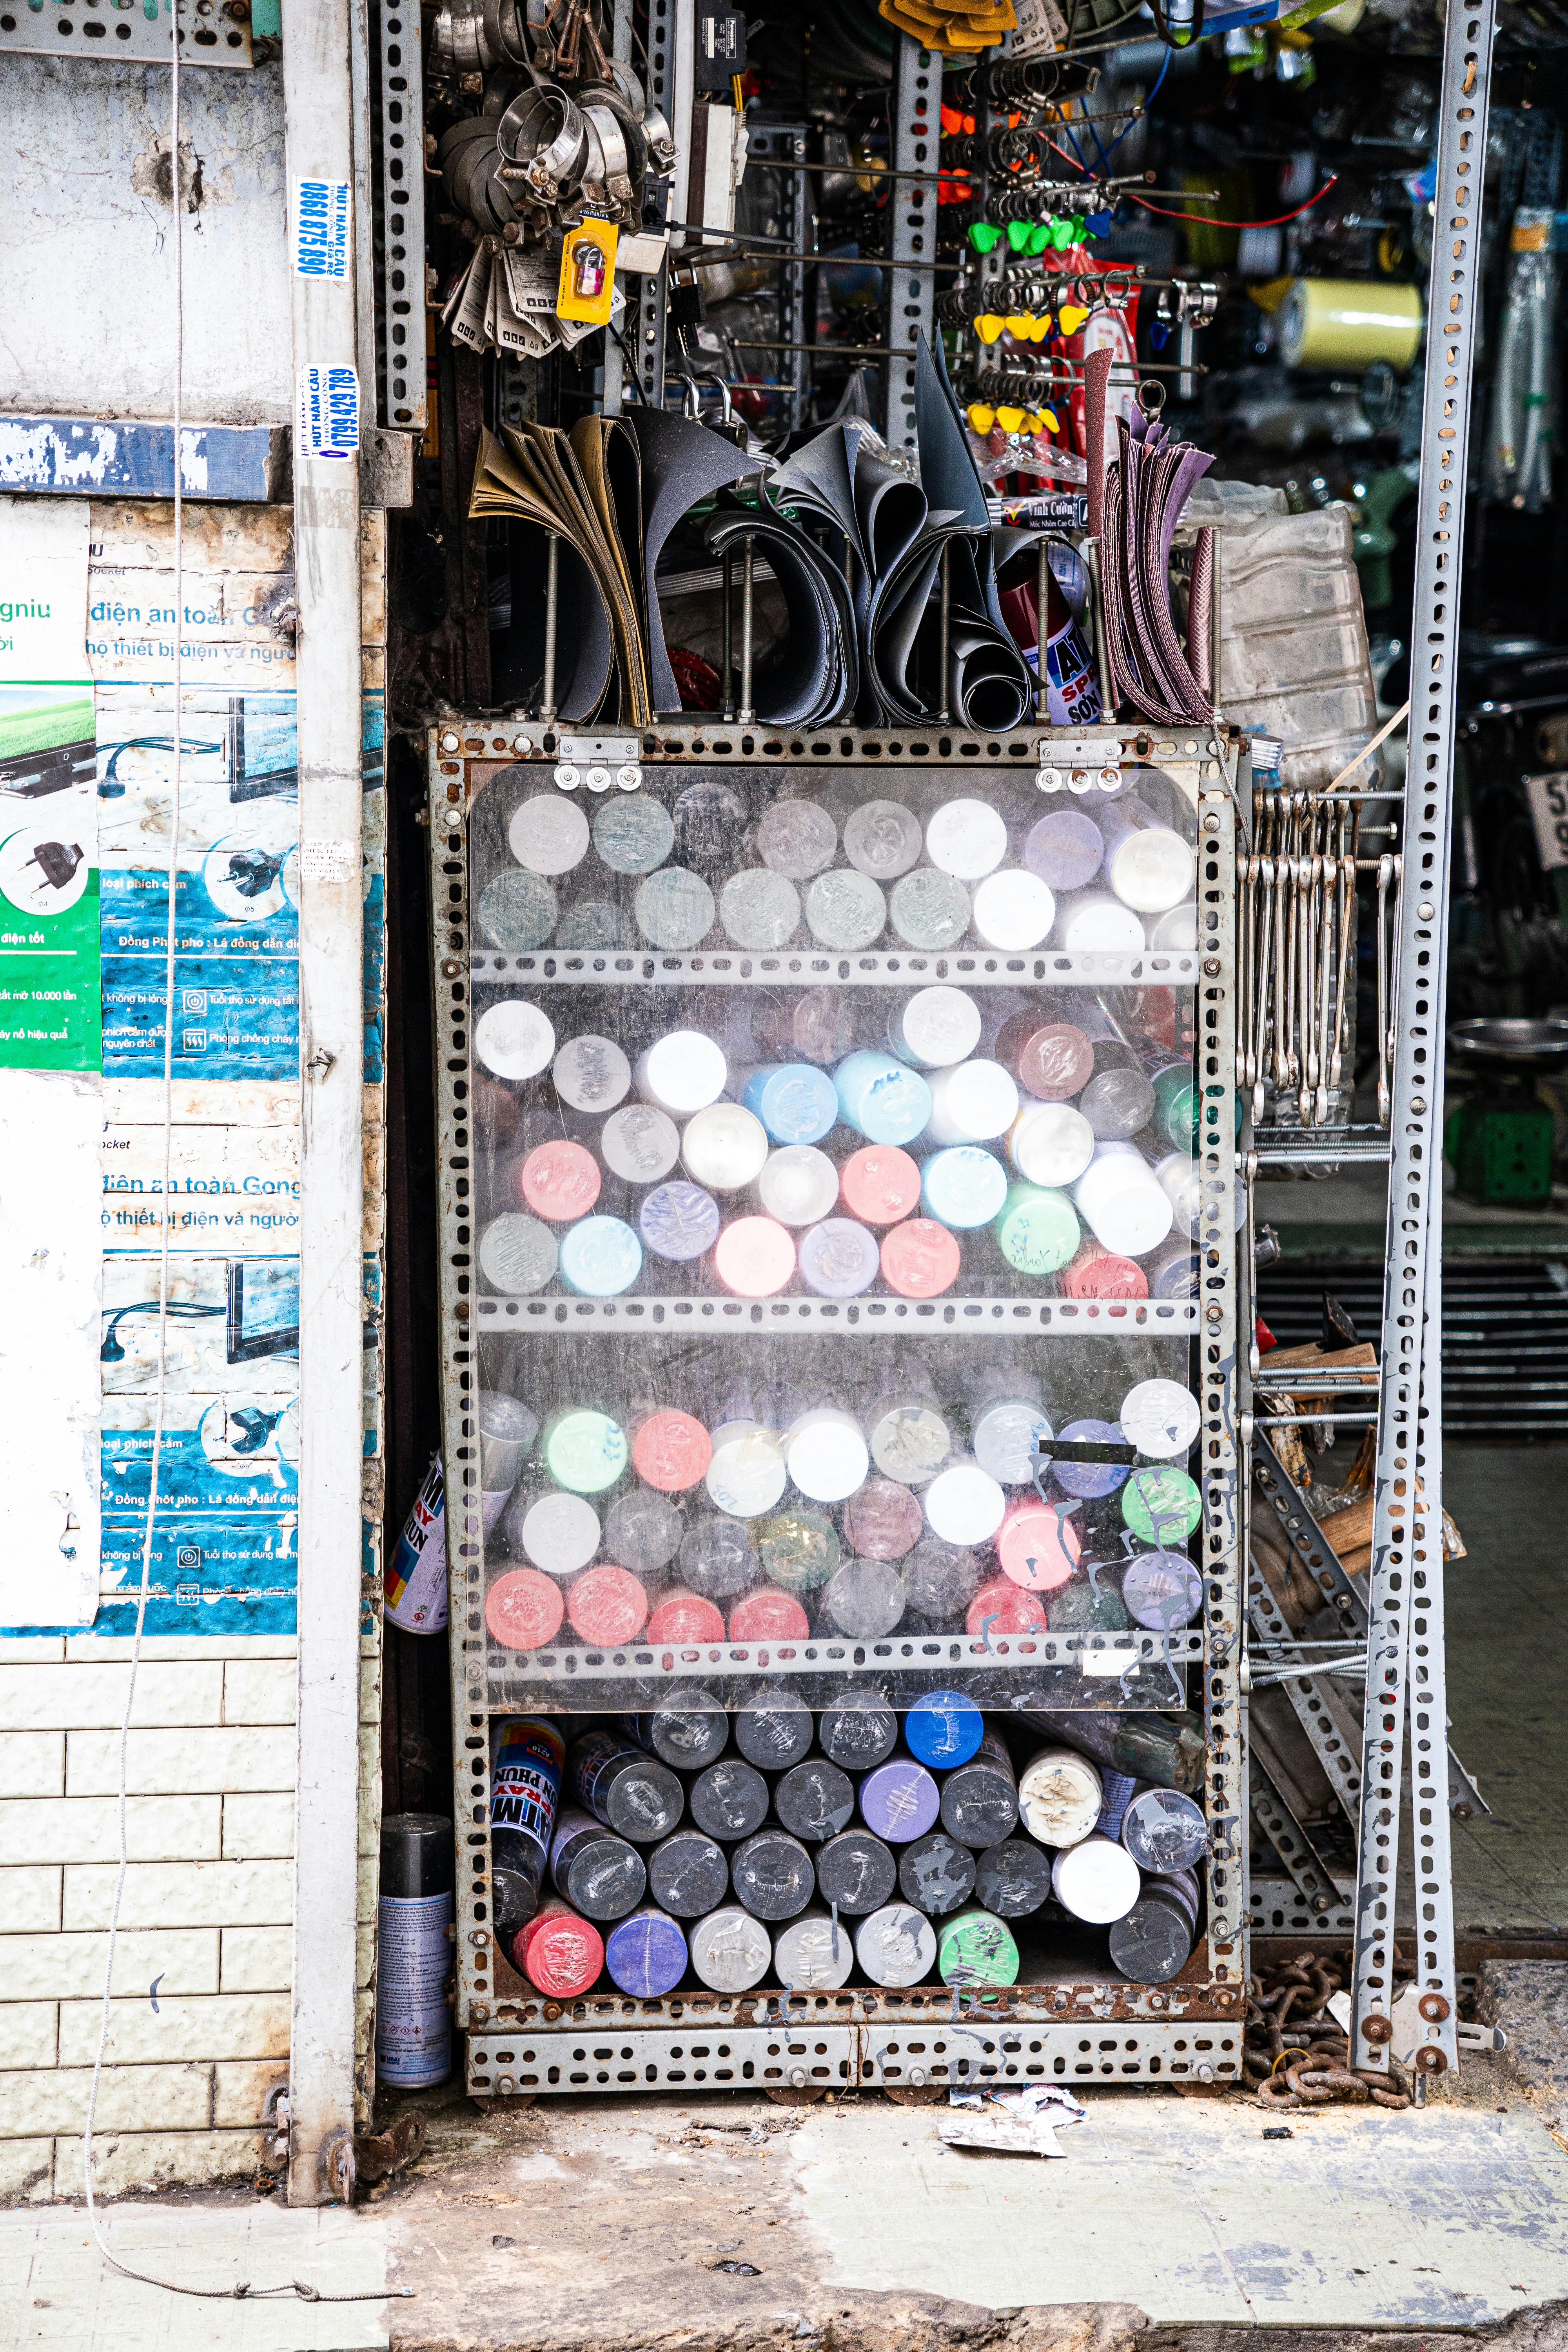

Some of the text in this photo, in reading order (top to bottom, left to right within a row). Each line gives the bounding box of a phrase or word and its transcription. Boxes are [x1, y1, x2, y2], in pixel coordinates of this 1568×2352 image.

[336, 186, 349, 212] HÚT
[298, 182, 329, 274] 0868.875.890
[335, 214, 348, 246] HẦM
[309, 395, 321, 421] HẦM
[328, 369, 358, 446] 0799.429.789
[310, 425, 321, 447] HÚT
[91, 602, 140, 626] điện
[149, 608, 176, 623] an
[114, 637, 153, 656] thiết
[159, 642, 175, 660] bị
[180, 643, 218, 661] điện
[1068, 689, 1101, 725] SƠN
[103, 878, 187, 891] loại phích cm
[0, 931, 45, 945] điện tốt
[118, 935, 149, 949] Đồng
[152, 935, 179, 948] Pht
[181, 937, 204, 949] pho
[214, 937, 229, 948] Lá
[230, 936, 259, 950] đồng
[262, 936, 283, 949] dẫn
[13, 990, 29, 1001] mở
[31, 991, 62, 1001] 10.000
[63, 989, 77, 1001] lần
[107, 994, 135, 1005] không
[137, 995, 147, 1004] bị
[209, 993, 295, 1007] Tuổi thọ sử dụng tắt
[13, 1029, 26, 1040] nổ
[27, 1029, 48, 1041] hiệu
[49, 1027, 68, 1042] quả
[209, 1033, 293, 1045] Phòng chống cháy
[103, 1038, 156, 1049] nguyên chất
[185, 1176, 235, 1194] toàn
[117, 1207, 155, 1225] thiết
[181, 1211, 218, 1229] điện
[224, 1212, 244, 1225] và
[160, 1438, 183, 1448] cắm
[114, 1494, 145, 1506] Đồng
[177, 1496, 198, 1506] pho
[209, 1495, 222, 1505] Lá
[225, 1495, 254, 1507] đồng
[256, 1494, 277, 1505] dẫn
[102, 1550, 130, 1561] không
[132, 1551, 141, 1561] bị
[203, 1548, 220, 1559] Tuổi
[222, 1551, 236, 1561] thọ
[238, 1550, 250, 1559] sử
[252, 1550, 273, 1561] dụng
[532, 1744, 550, 1758] A210
[492, 1767, 541, 1789] PHUN
[492, 1797, 553, 1850] ATM
